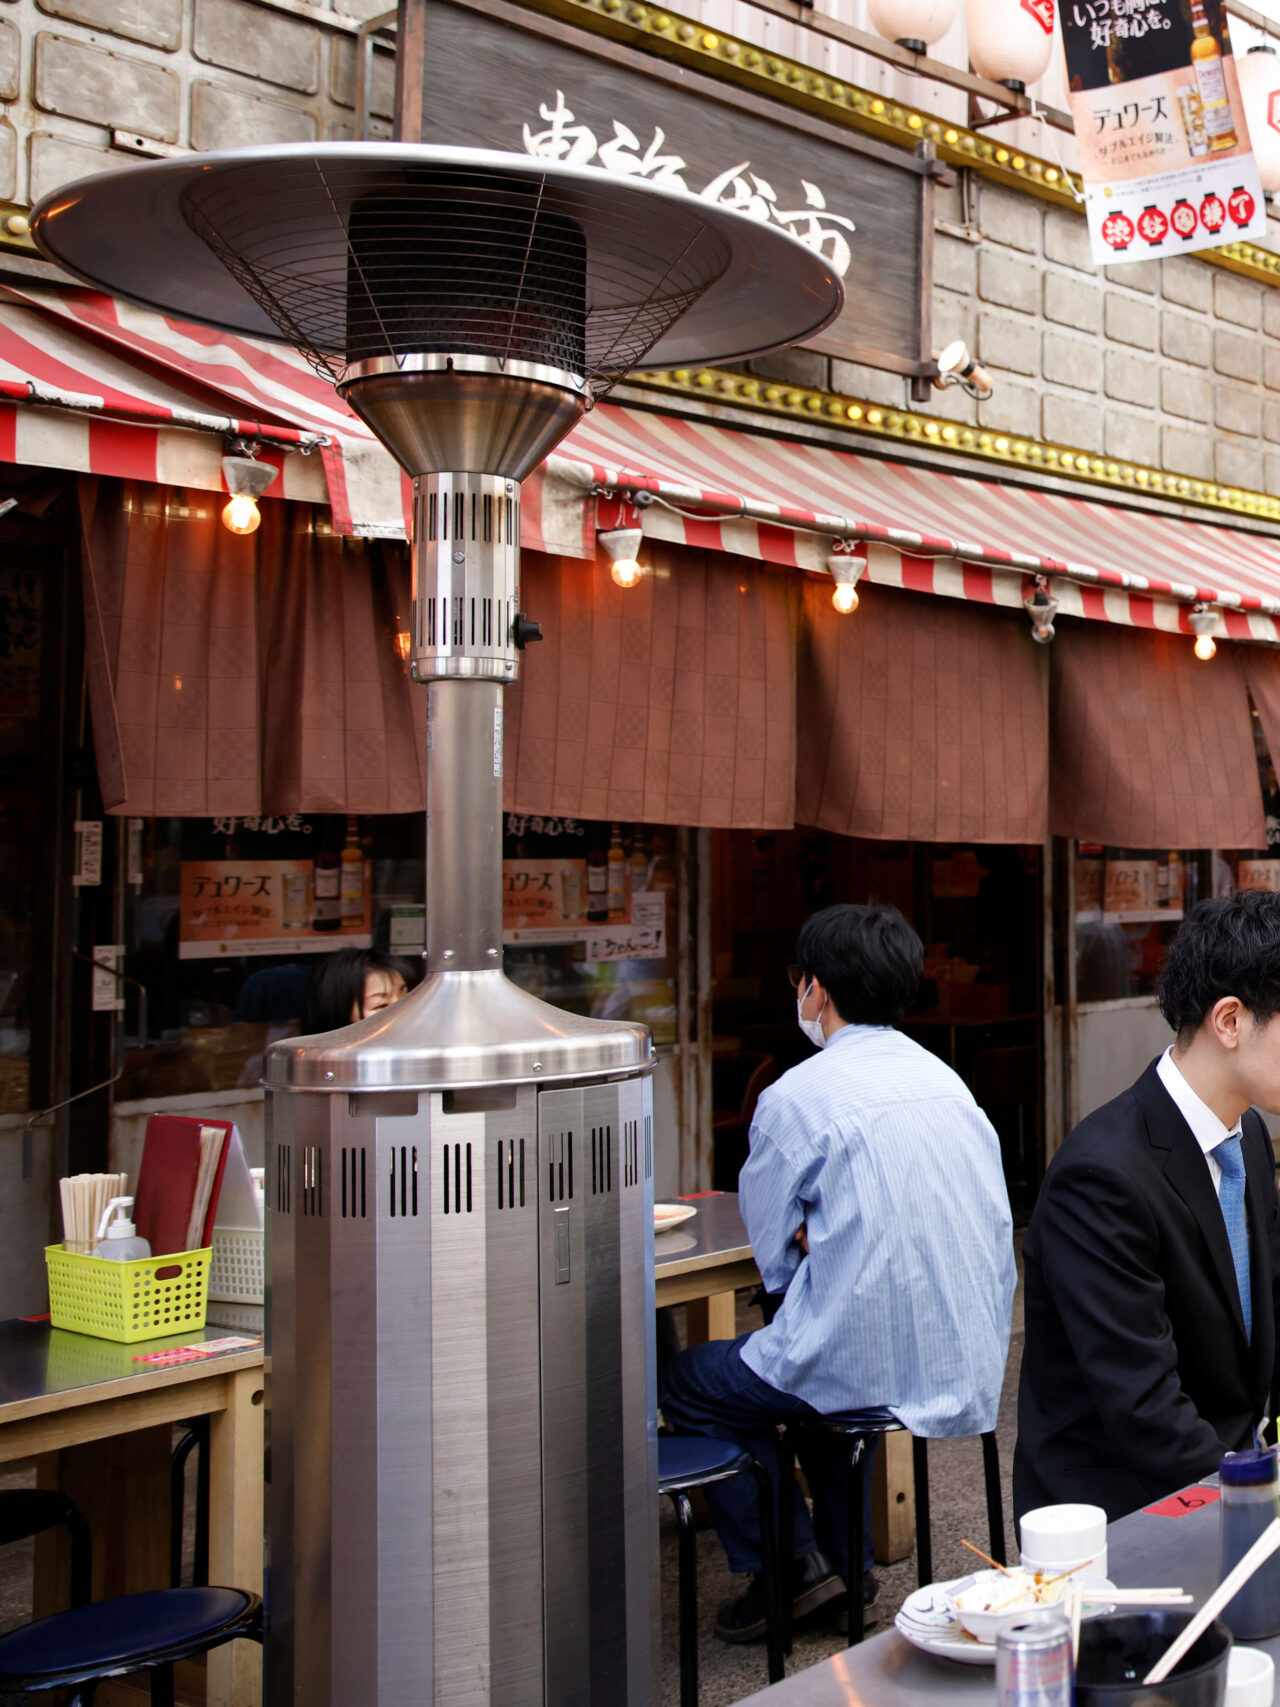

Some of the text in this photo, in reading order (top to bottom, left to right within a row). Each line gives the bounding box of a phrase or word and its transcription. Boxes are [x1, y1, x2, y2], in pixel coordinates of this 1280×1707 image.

[1090, 9, 1172, 50] 好奇心を。
[1093, 96, 1169, 135] デュワーズ
[192, 874, 273, 898] デュワーズ
[503, 872, 553, 892] ュワーズ
